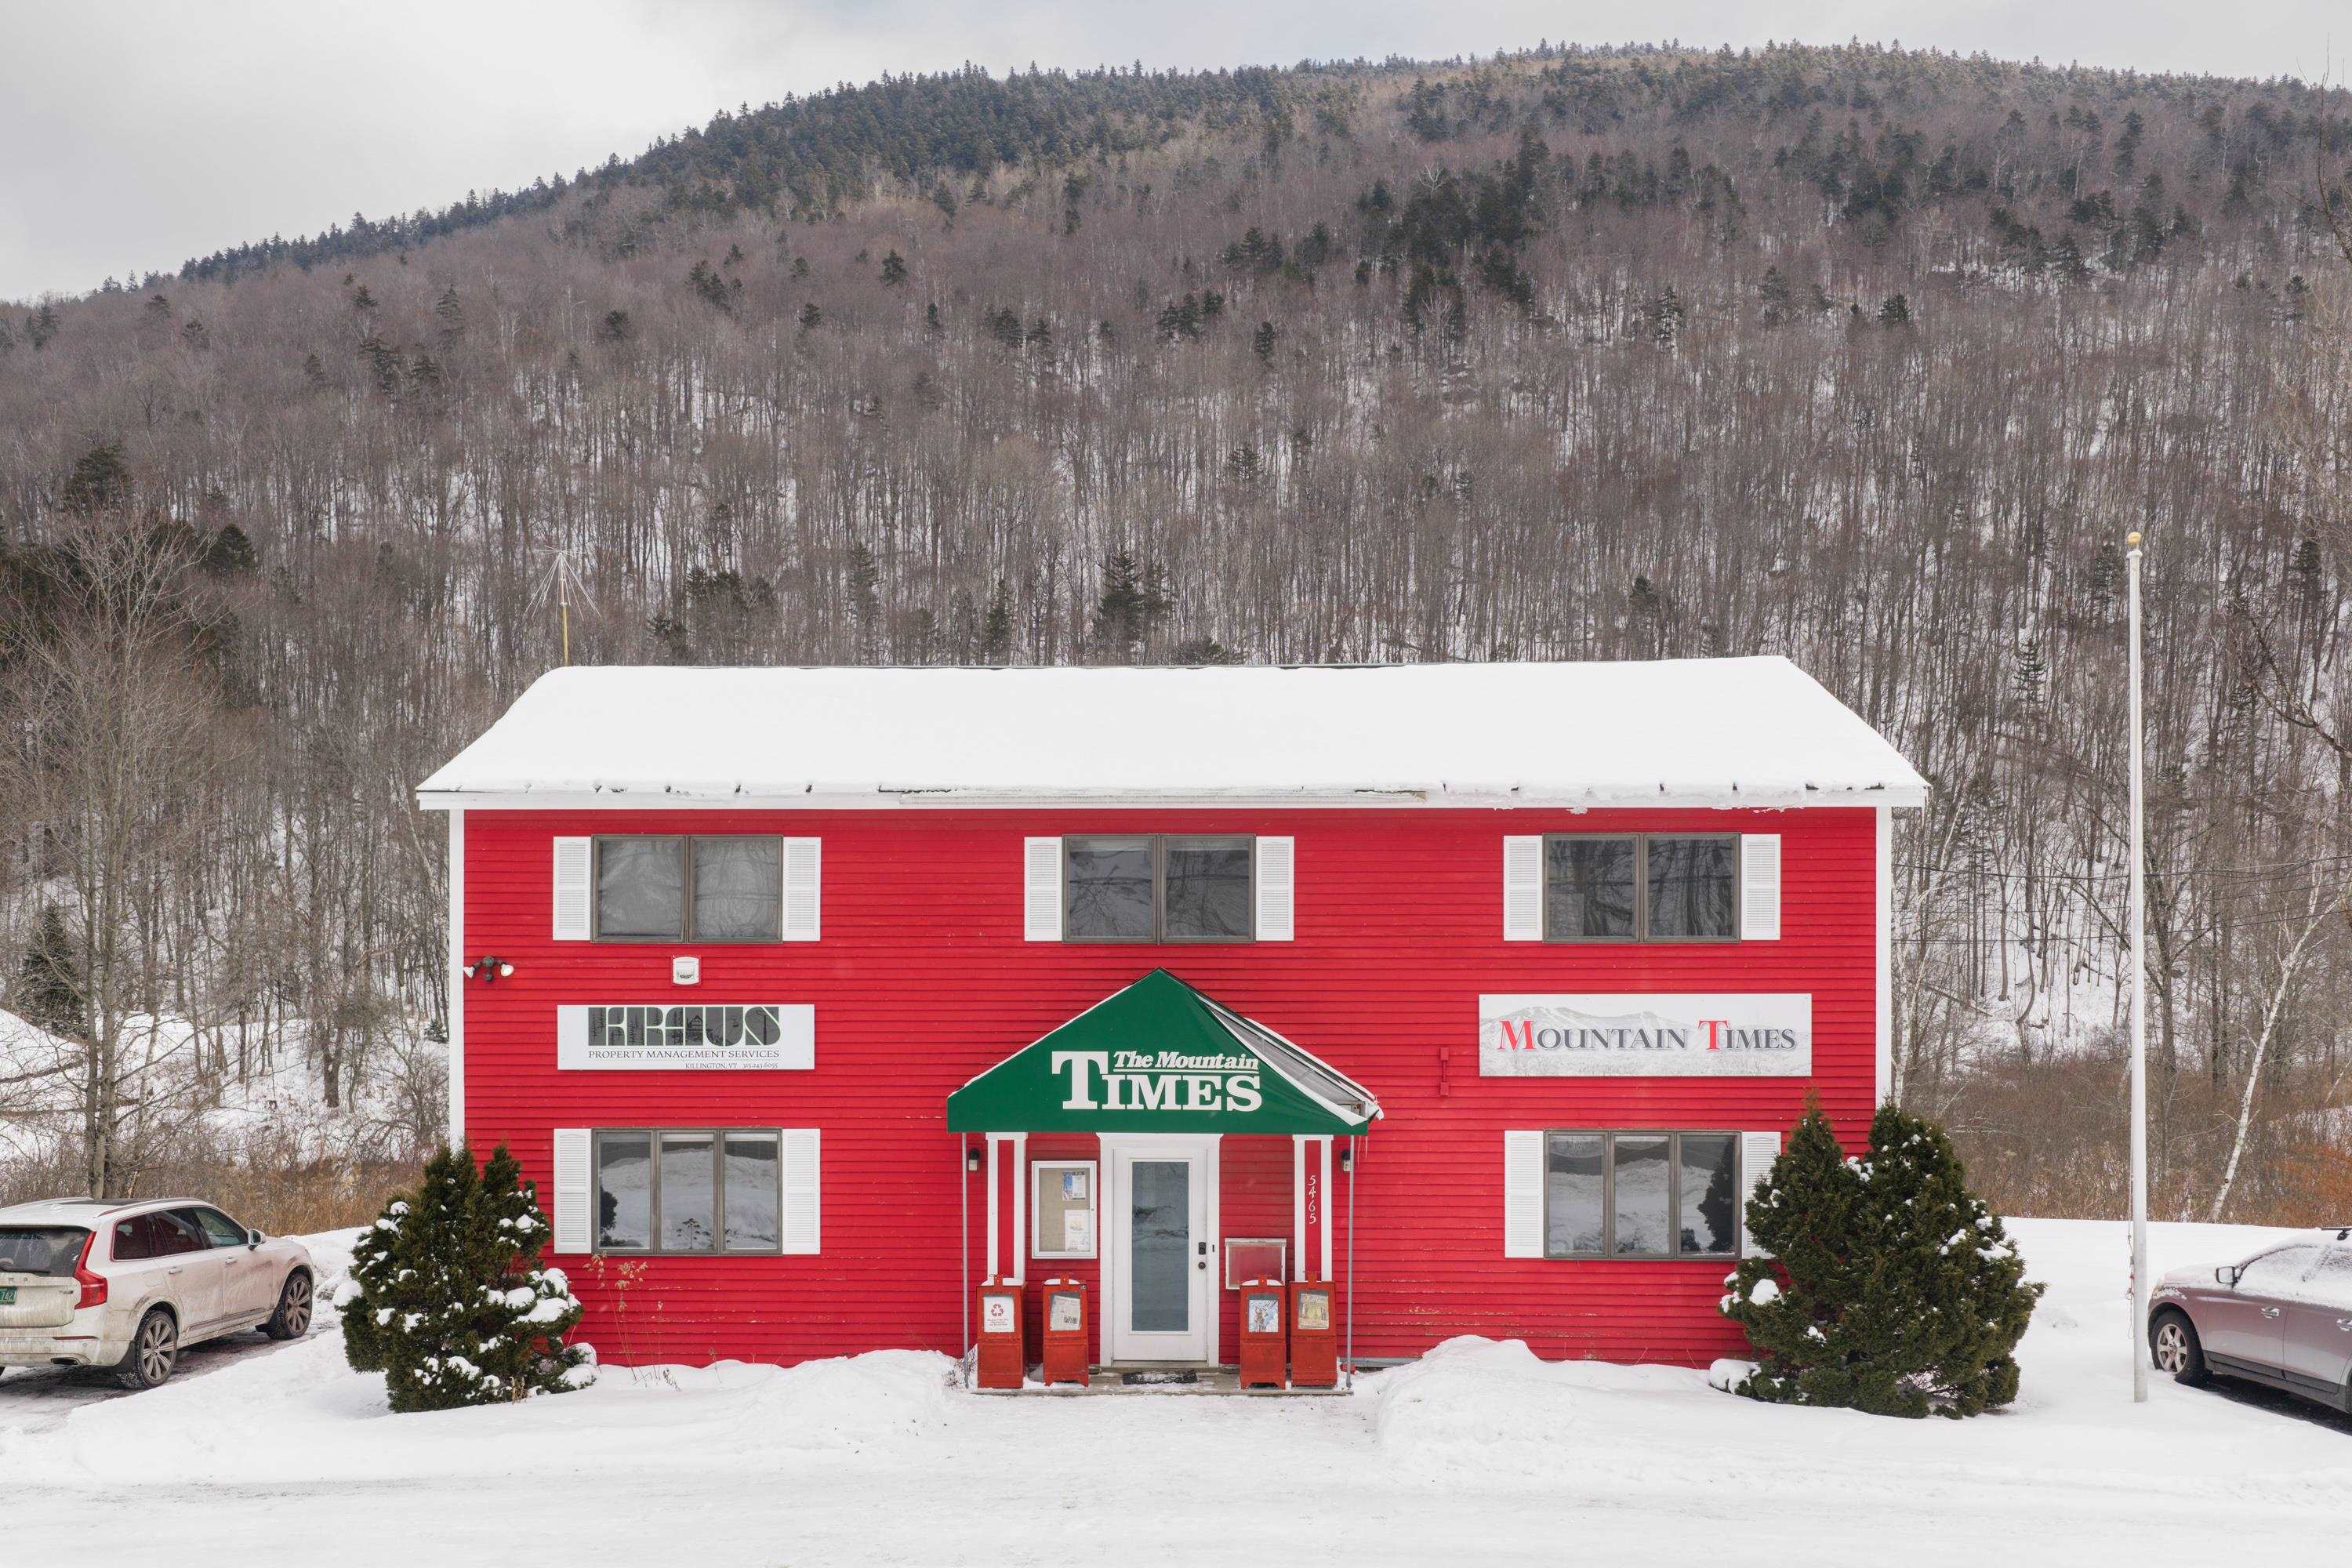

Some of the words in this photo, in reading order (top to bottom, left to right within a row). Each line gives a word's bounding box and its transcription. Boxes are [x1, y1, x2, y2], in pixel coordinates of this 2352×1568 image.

[588, 1007, 781, 1047] KRAUS
[1498, 1020, 1686, 1051] MOUNTAIN
[1697, 1020, 1796, 1051] TIMES
[1113, 1051, 1154, 1069] The
[1155, 1051, 1259, 1070] Mountain
[1051, 1051, 1262, 1112] TIMES
[1308, 1174, 1317, 1225] 5465
